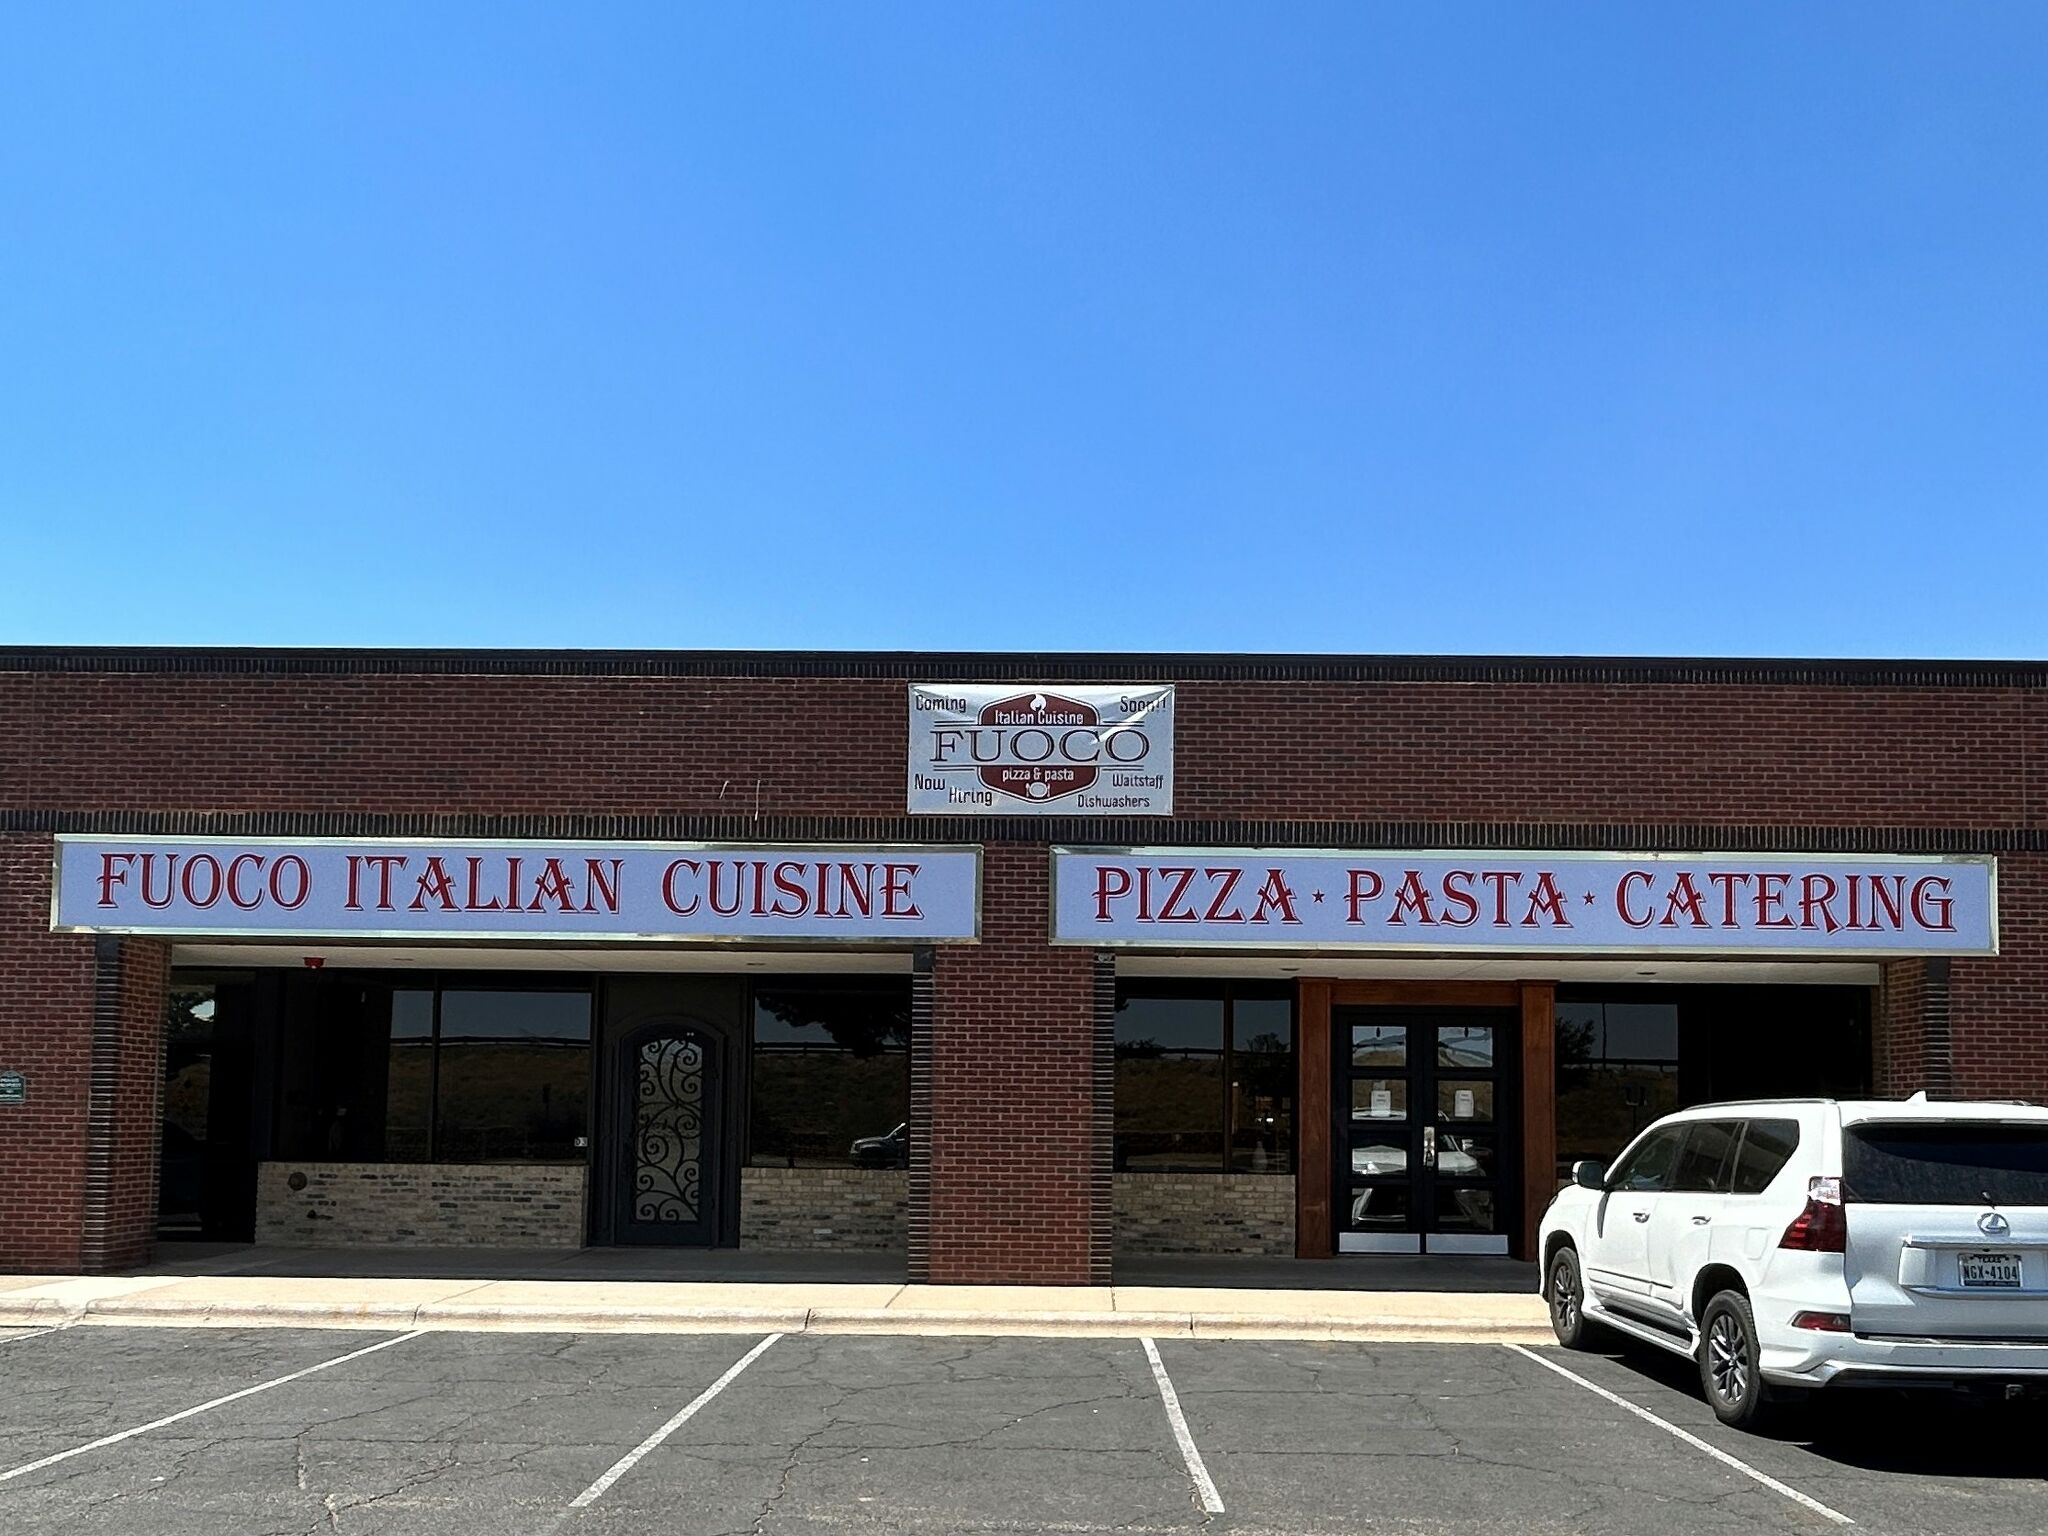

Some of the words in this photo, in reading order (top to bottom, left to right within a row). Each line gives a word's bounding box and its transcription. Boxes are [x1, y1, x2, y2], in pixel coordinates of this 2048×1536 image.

[915, 694, 967, 713] Coming
[994, 709, 1034, 725] Italian
[1037, 709, 1084, 725] Cuisine
[929, 729, 1150, 763] FUOCO
[914, 773, 946, 791] Now
[1002, 769, 1031, 782] pizza
[1033, 767, 1041, 781] &
[1044, 768, 1074, 782] pasta
[1112, 773, 1164, 790] Waitstaff
[949, 783, 993, 807] Hiring
[1077, 794, 1150, 808] Dishwashers
[96, 852, 313, 911] FUOCO
[344, 855, 626, 914] ITALIAN
[661, 858, 925, 920] CUISINE
[1092, 866, 1304, 925] PIZZA
[1343, 869, 1574, 929] PASTA
[1615, 869, 1958, 935] CATERING
